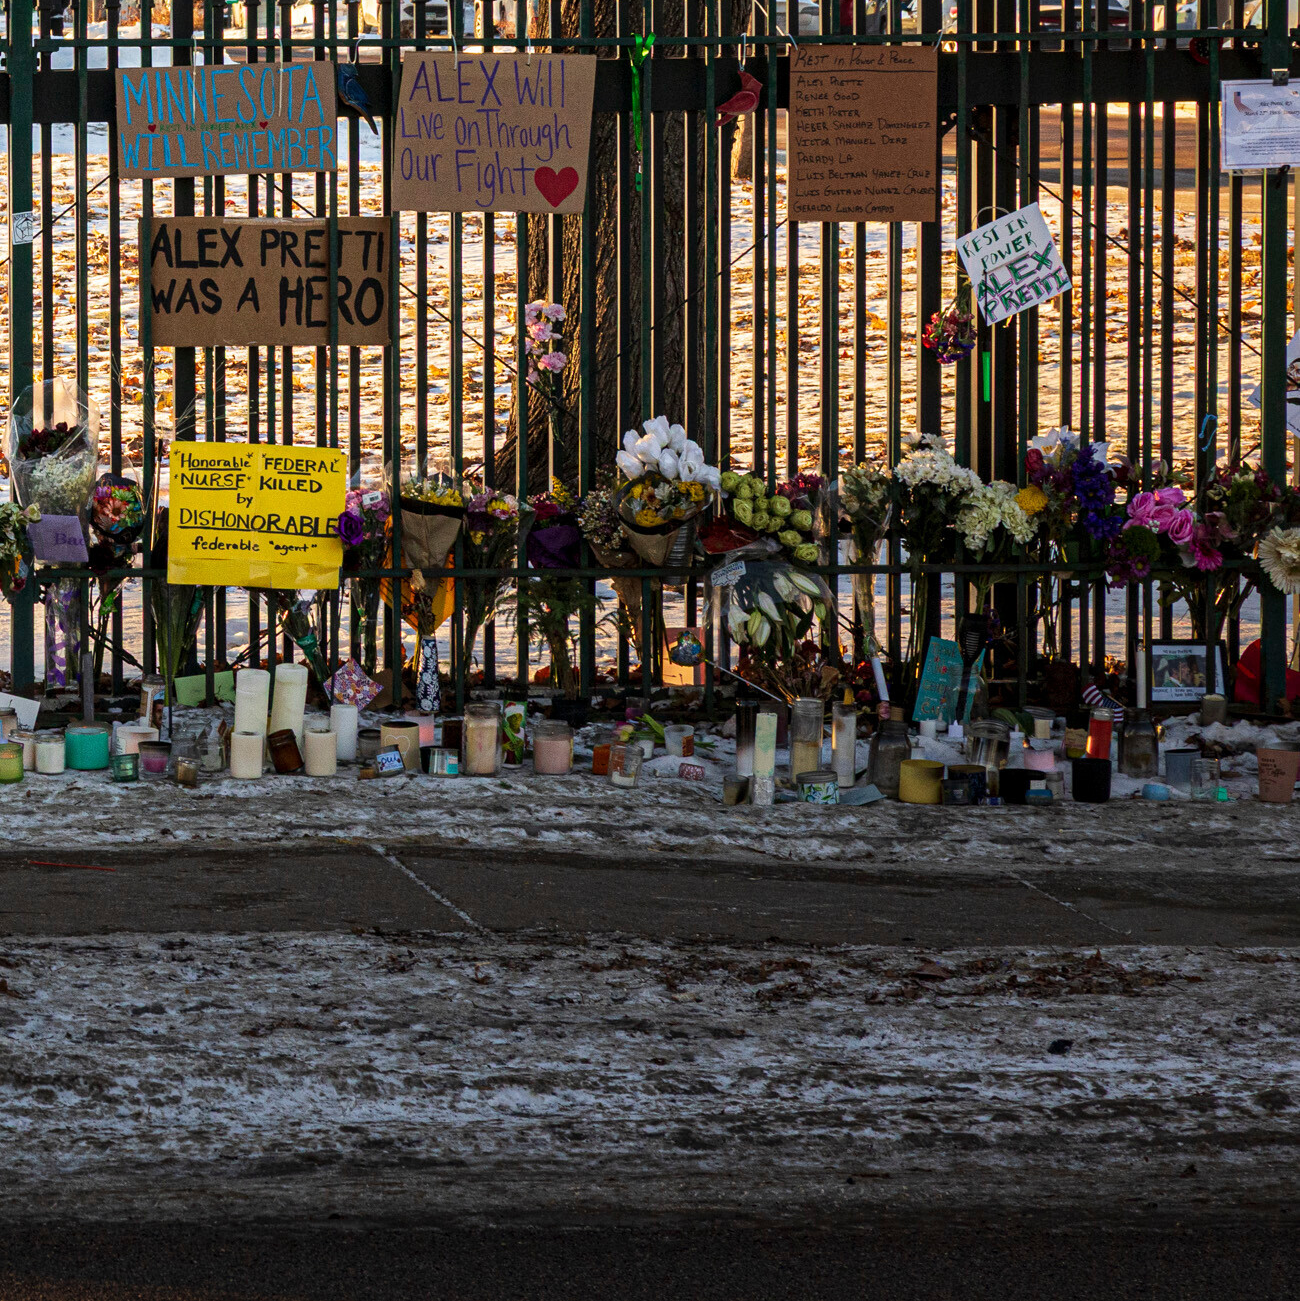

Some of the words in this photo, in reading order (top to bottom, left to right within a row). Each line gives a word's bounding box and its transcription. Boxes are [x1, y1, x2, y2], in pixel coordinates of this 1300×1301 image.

[794, 50, 829, 67] REST
[834, 55, 844, 65] in
[850, 48, 875, 67] Power
[122, 65, 325, 125] MINNESOTA
[409, 60, 502, 106] ALEX
[514, 59, 565, 108] Will
[795, 91, 828, 101] RENEE
[834, 91, 860, 100] GOOD
[795, 105, 824, 117] KEITH
[797, 120, 828, 133] HEBER
[160, 124, 180, 132] REST
[401, 107, 445, 140] Live
[476, 108, 572, 162] Through
[795, 137, 830, 147] VICTOR
[835, 137, 876, 146] MANUEL
[881, 135, 908, 145] DIAZ
[121, 131, 200, 171] WILL
[200, 125, 336, 171] REMEMBER
[400, 147, 442, 182] Our
[455, 150, 535, 207] Fight
[796, 169, 824, 181] LUIS
[828, 169, 868, 178] BELTRAN
[151, 223, 244, 269] ALEX
[261, 229, 384, 273] PRETTI
[962, 225, 1000, 258] REST
[1005, 215, 1028, 236] IN
[980, 231, 1037, 270] POWER
[977, 241, 1053, 301] ALEX
[150, 277, 222, 314] WAS
[236, 278, 260, 313] A
[279, 275, 384, 328] HERO
[984, 266, 1068, 322] PRETTI
[236, 493, 253, 508] by
[259, 476, 323, 493] KILLED
[179, 508, 338, 536] DISHONORABLE
[192, 536, 260, 552] federable
